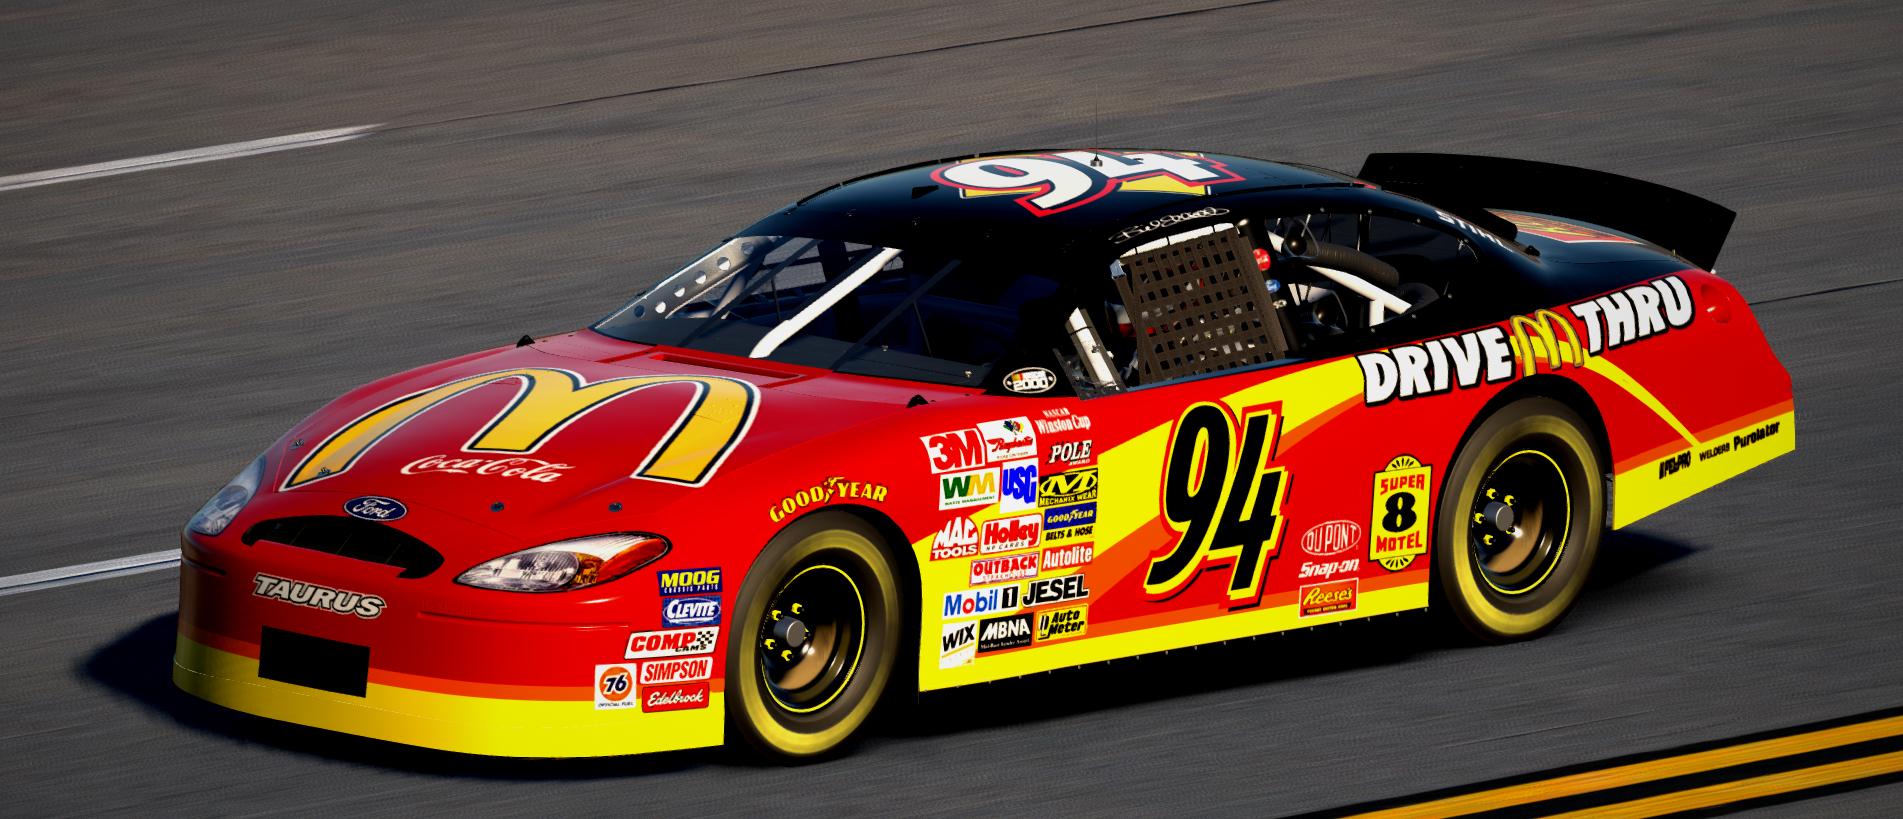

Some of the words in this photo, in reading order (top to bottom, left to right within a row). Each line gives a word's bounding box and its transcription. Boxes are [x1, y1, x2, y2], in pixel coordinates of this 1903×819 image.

[940, 150, 1222, 211] 94
[1357, 326, 1514, 405] DRIVE
[1570, 275, 1694, 356] THRU
[1013, 379, 1049, 391] 2000
[1035, 418, 1073, 434] Winston
[1072, 414, 1092, 430] Cup
[928, 430, 983, 471] 3M
[1047, 440, 1092, 463] POLE
[1699, 443, 1730, 461] WELDERS
[1733, 421, 1780, 451] Purolator
[400, 454, 576, 483] Coca-Cola
[942, 472, 996, 499] WM
[1002, 464, 1037, 504] USG
[1380, 473, 1425, 495] SUPER
[352, 498, 397, 518] Ford
[1039, 495, 1076, 506] MECHANIX
[1076, 490, 1097, 501] WEAR
[1144, 401, 1288, 602] 94
[1382, 491, 1417, 533] 8
[933, 516, 979, 549] MAC
[983, 519, 1040, 547] Holley
[1045, 531, 1065, 541] BELTS
[1066, 529, 1073, 538] &
[1074, 526, 1093, 536] HOSE
[1376, 530, 1422, 553] MOTEL
[931, 545, 978, 560] TOOLS
[1043, 547, 1093, 569] Autolite
[973, 555, 1037, 577] OUTBACK
[1298, 559, 1360, 579] Snap-on
[661, 569, 720, 588] MOOG
[252, 572, 387, 619] TAURUS
[1022, 575, 1089, 607] JESEL
[666, 599, 716, 619] CLEVITE
[943, 588, 999, 617] Mobil
[1051, 610, 1081, 624] Auto
[942, 623, 975, 652] WIX
[980, 618, 1031, 642] MBNA
[1049, 621, 1085, 636] Meter
[630, 632, 697, 653] COMP
[675, 643, 707, 653] CAMS
[644, 660, 708, 681] SIMPSON
[603, 674, 629, 694] 76
[647, 688, 705, 707] Edelbrock
